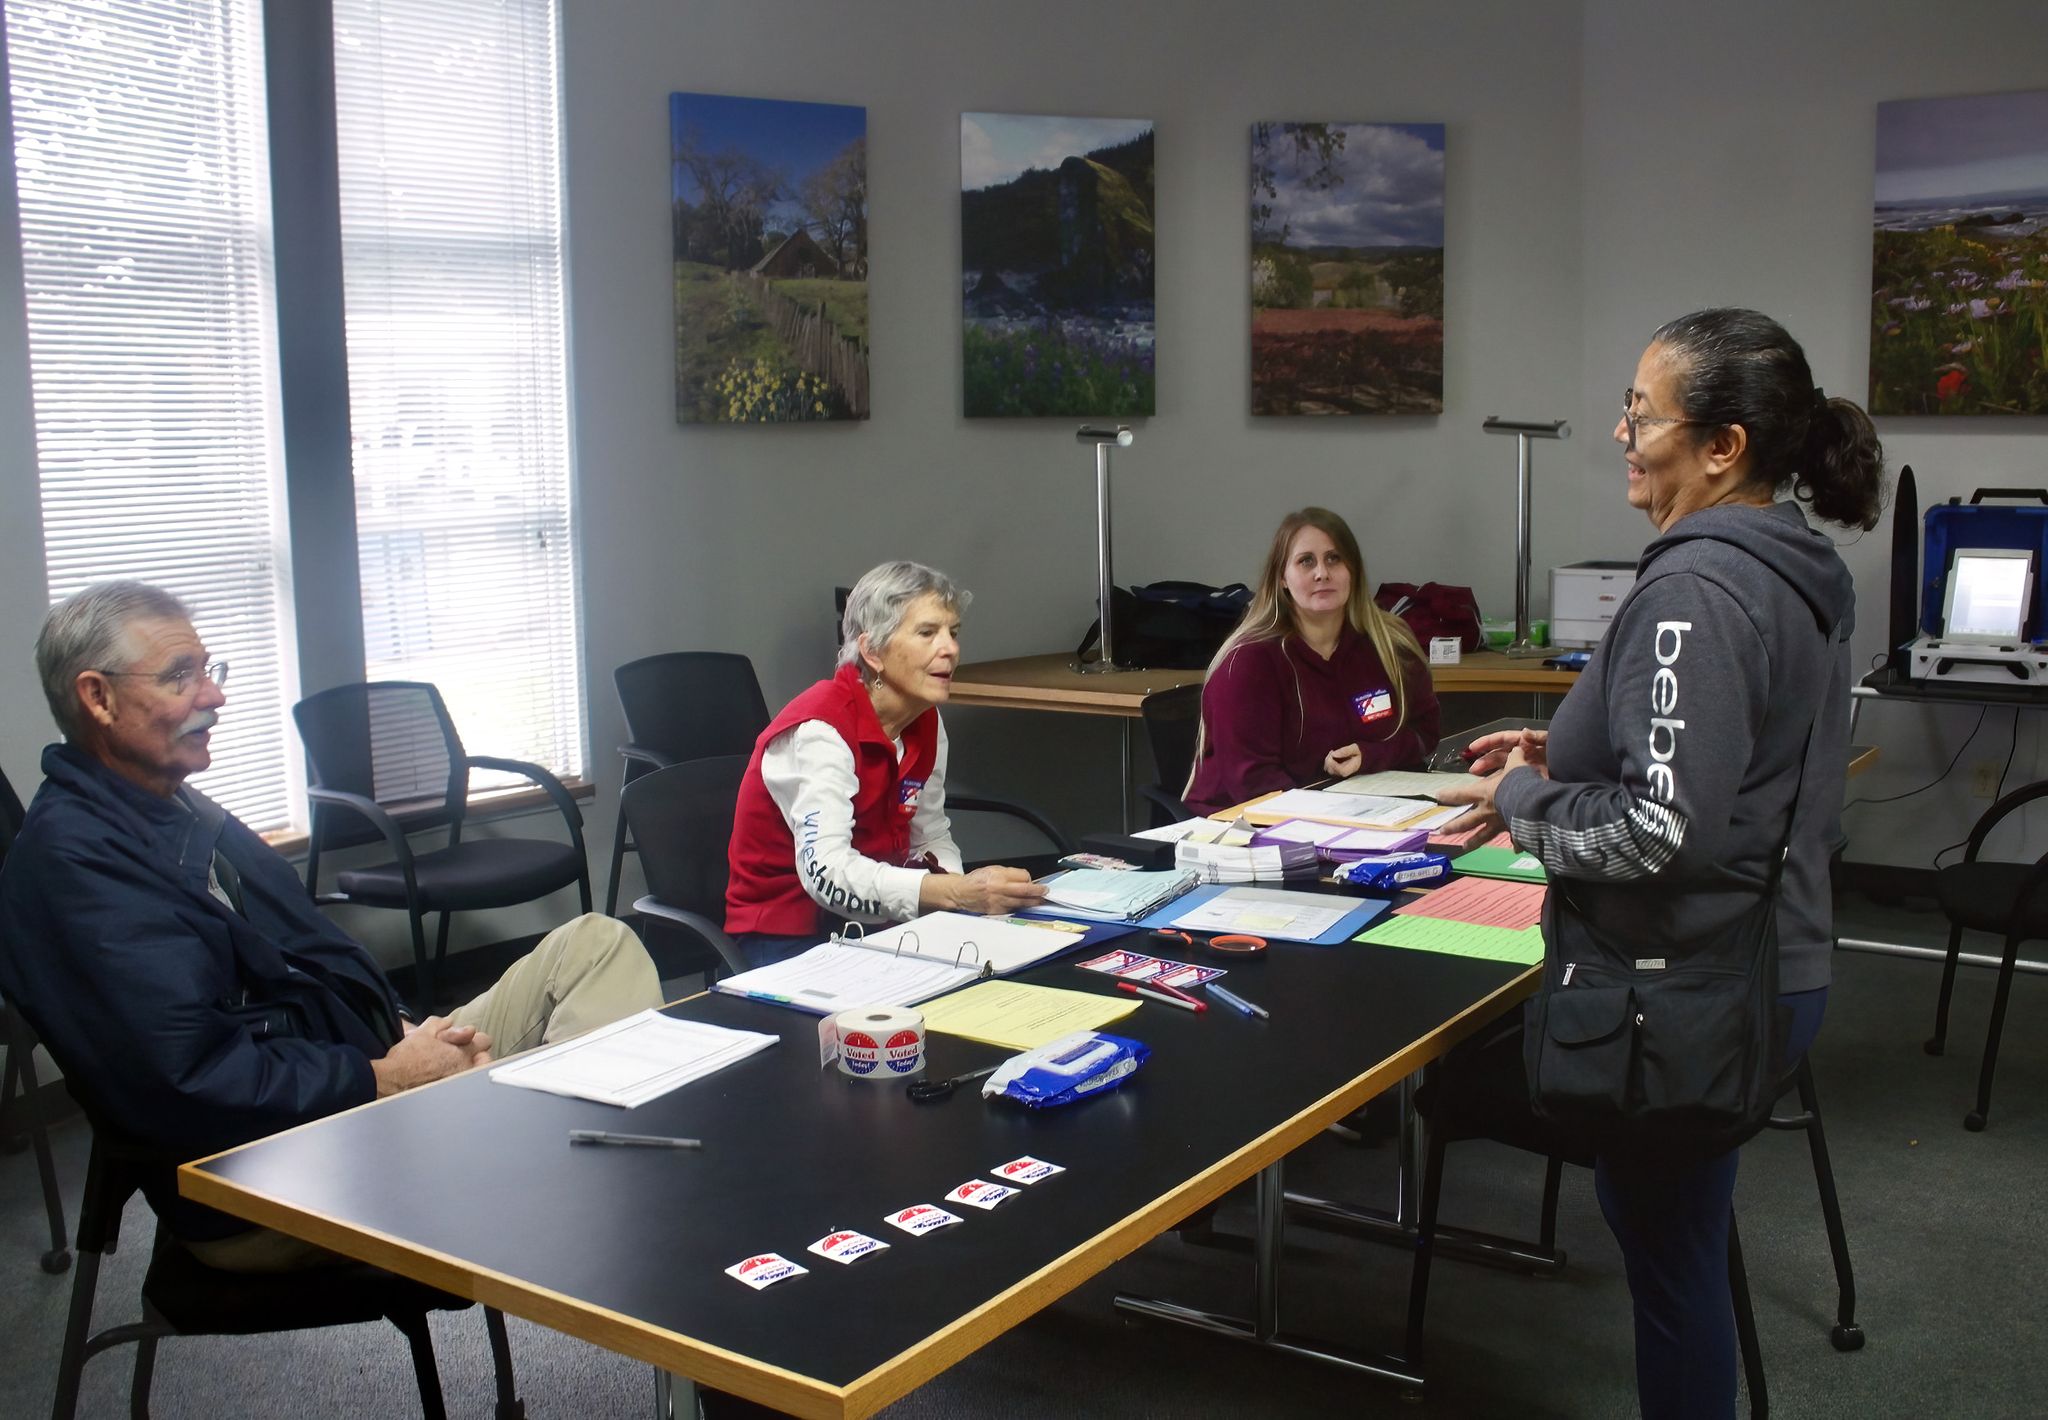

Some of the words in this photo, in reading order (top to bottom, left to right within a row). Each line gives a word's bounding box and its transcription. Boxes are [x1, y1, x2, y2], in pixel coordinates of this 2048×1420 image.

[1646, 620, 1693, 805] bebe
[846, 1047, 875, 1060] Voted
[889, 1044, 918, 1059] Voted
